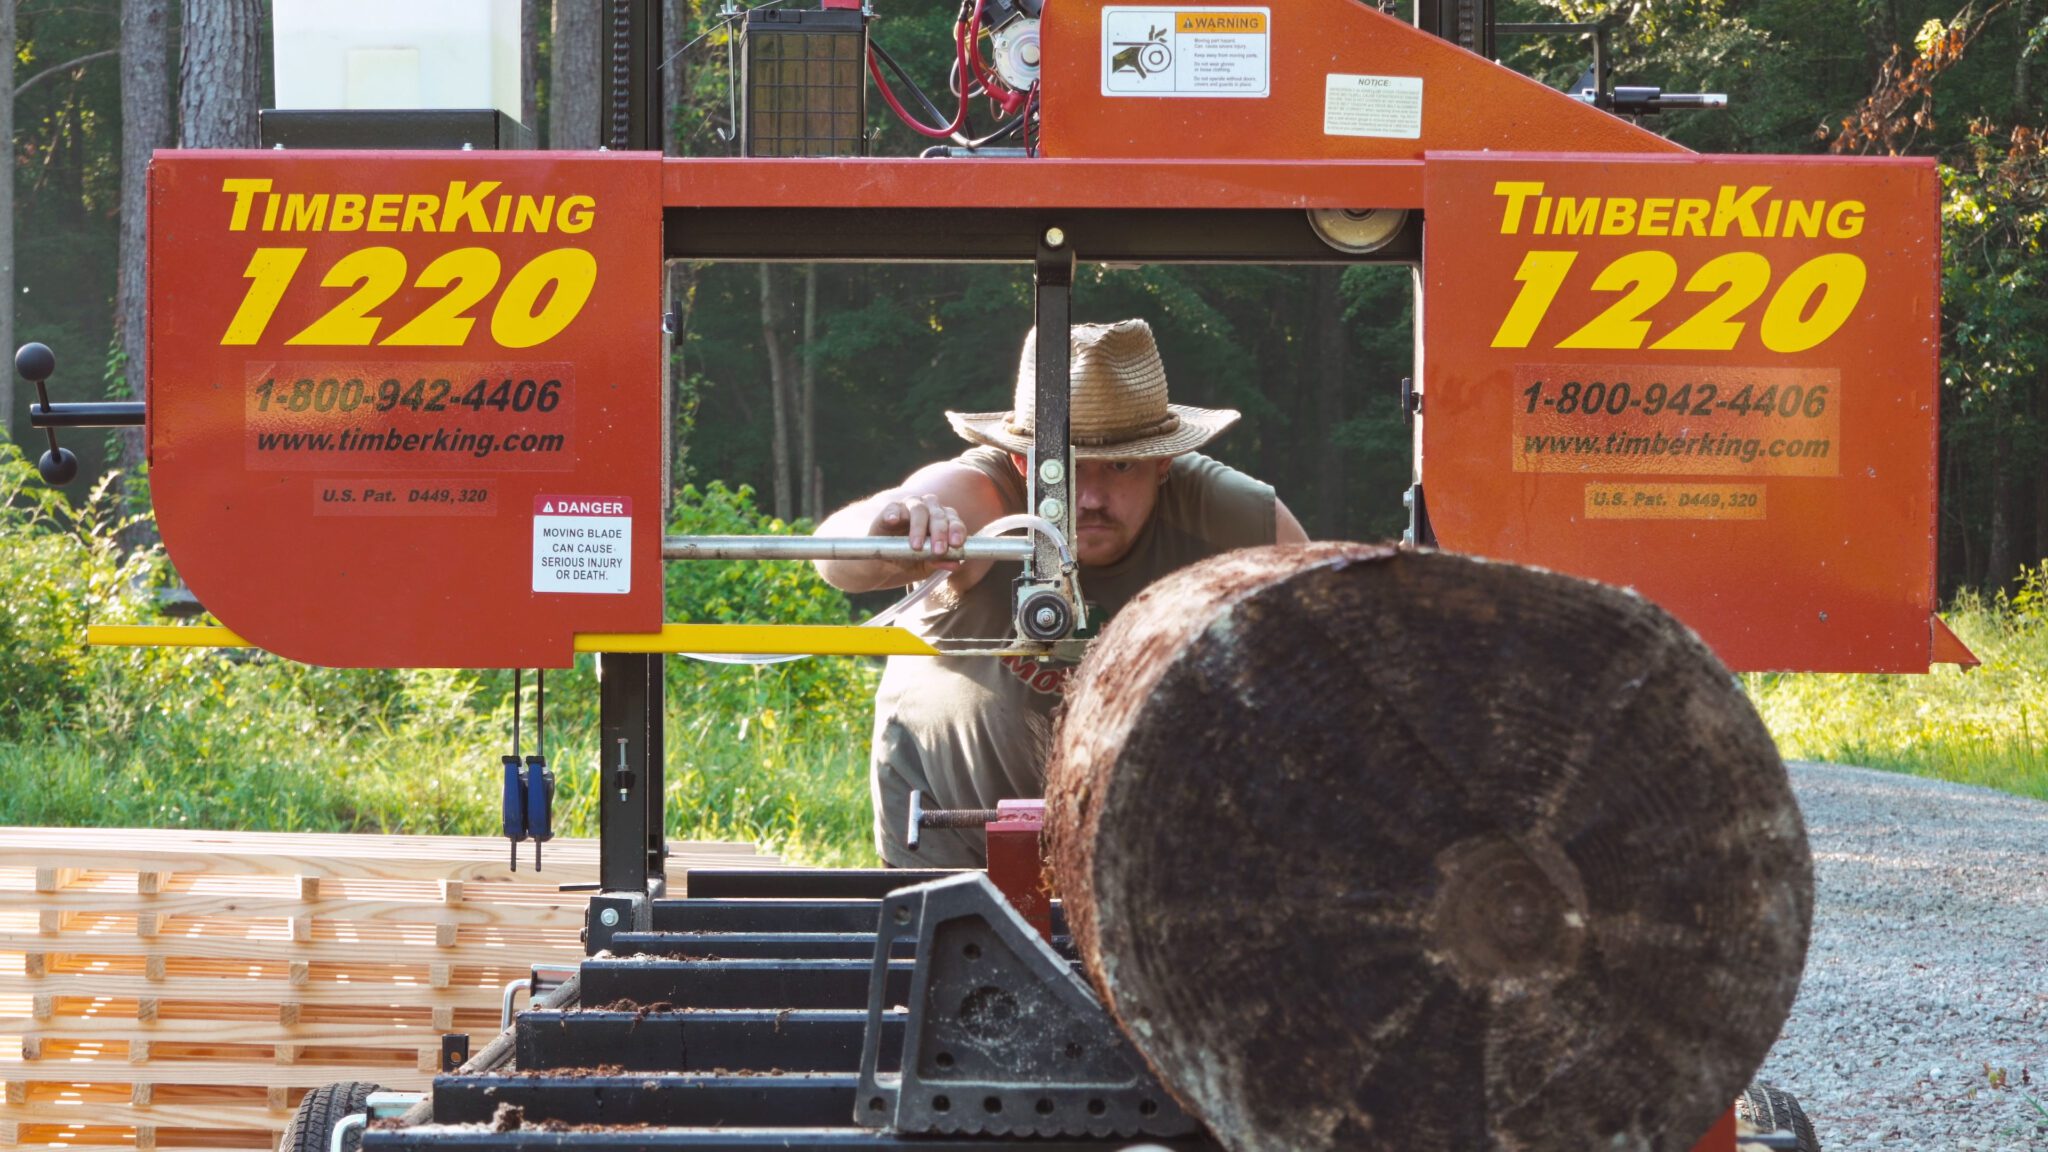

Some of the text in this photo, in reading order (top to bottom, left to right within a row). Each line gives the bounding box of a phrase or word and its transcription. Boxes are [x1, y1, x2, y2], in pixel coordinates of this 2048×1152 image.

[1195, 17, 1259, 29] WARNING
[1358, 78, 1392, 87] NOTICE:
[220, 246, 598, 349] 1220
[1490, 250, 1868, 353] 1220
[255, 377, 562, 413] 1-800-942-4406
[1523, 380, 1829, 418] 1-800-942-4406
[257, 427, 565, 458] www.timberking.com
[1524, 432, 1831, 463] www.timberking.com
[322, 489, 356, 503] U.S.
[363, 489, 396, 502] Pat.
[1593, 492, 1627, 506] U.S.
[1633, 492, 1667, 506] Pat.
[558, 501, 623, 514] DANGER
[543, 528, 622, 539] MOVING BLADE
[552, 543, 613, 553] CAN CAUSE
[541, 557, 623, 568] SERIOUS INJURY
[556, 569, 608, 580] OR DEATH.
